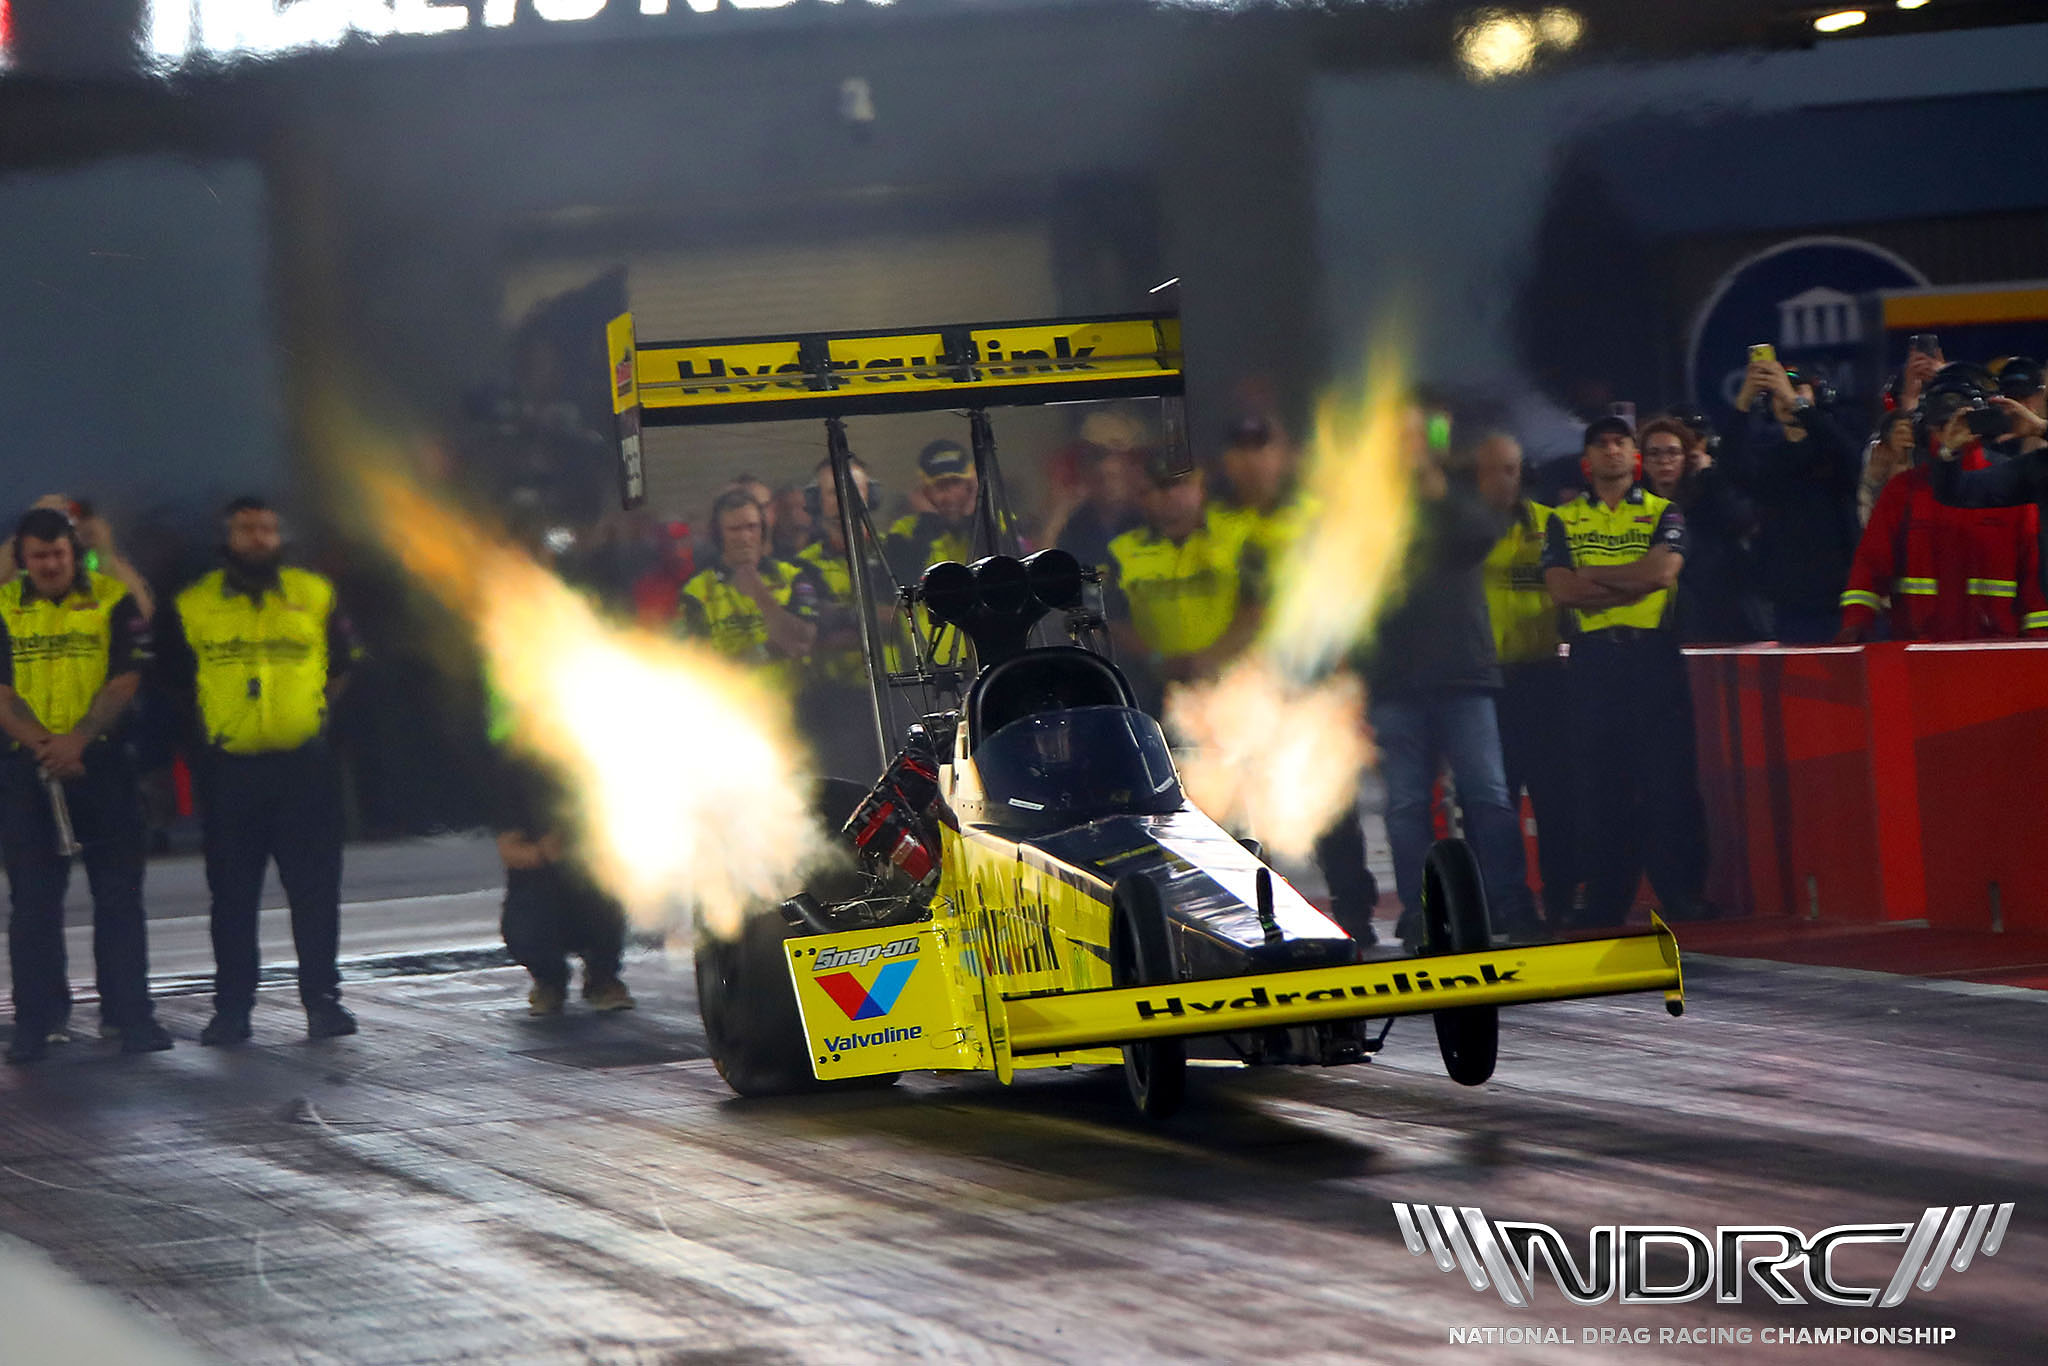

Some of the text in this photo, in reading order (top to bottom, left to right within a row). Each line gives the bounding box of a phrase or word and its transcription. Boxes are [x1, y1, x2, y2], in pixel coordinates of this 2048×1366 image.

[813, 937, 919, 971] Snap-on
[1136, 963, 1523, 1019] Hydraulink
[824, 1025, 922, 1052] Valvoline
